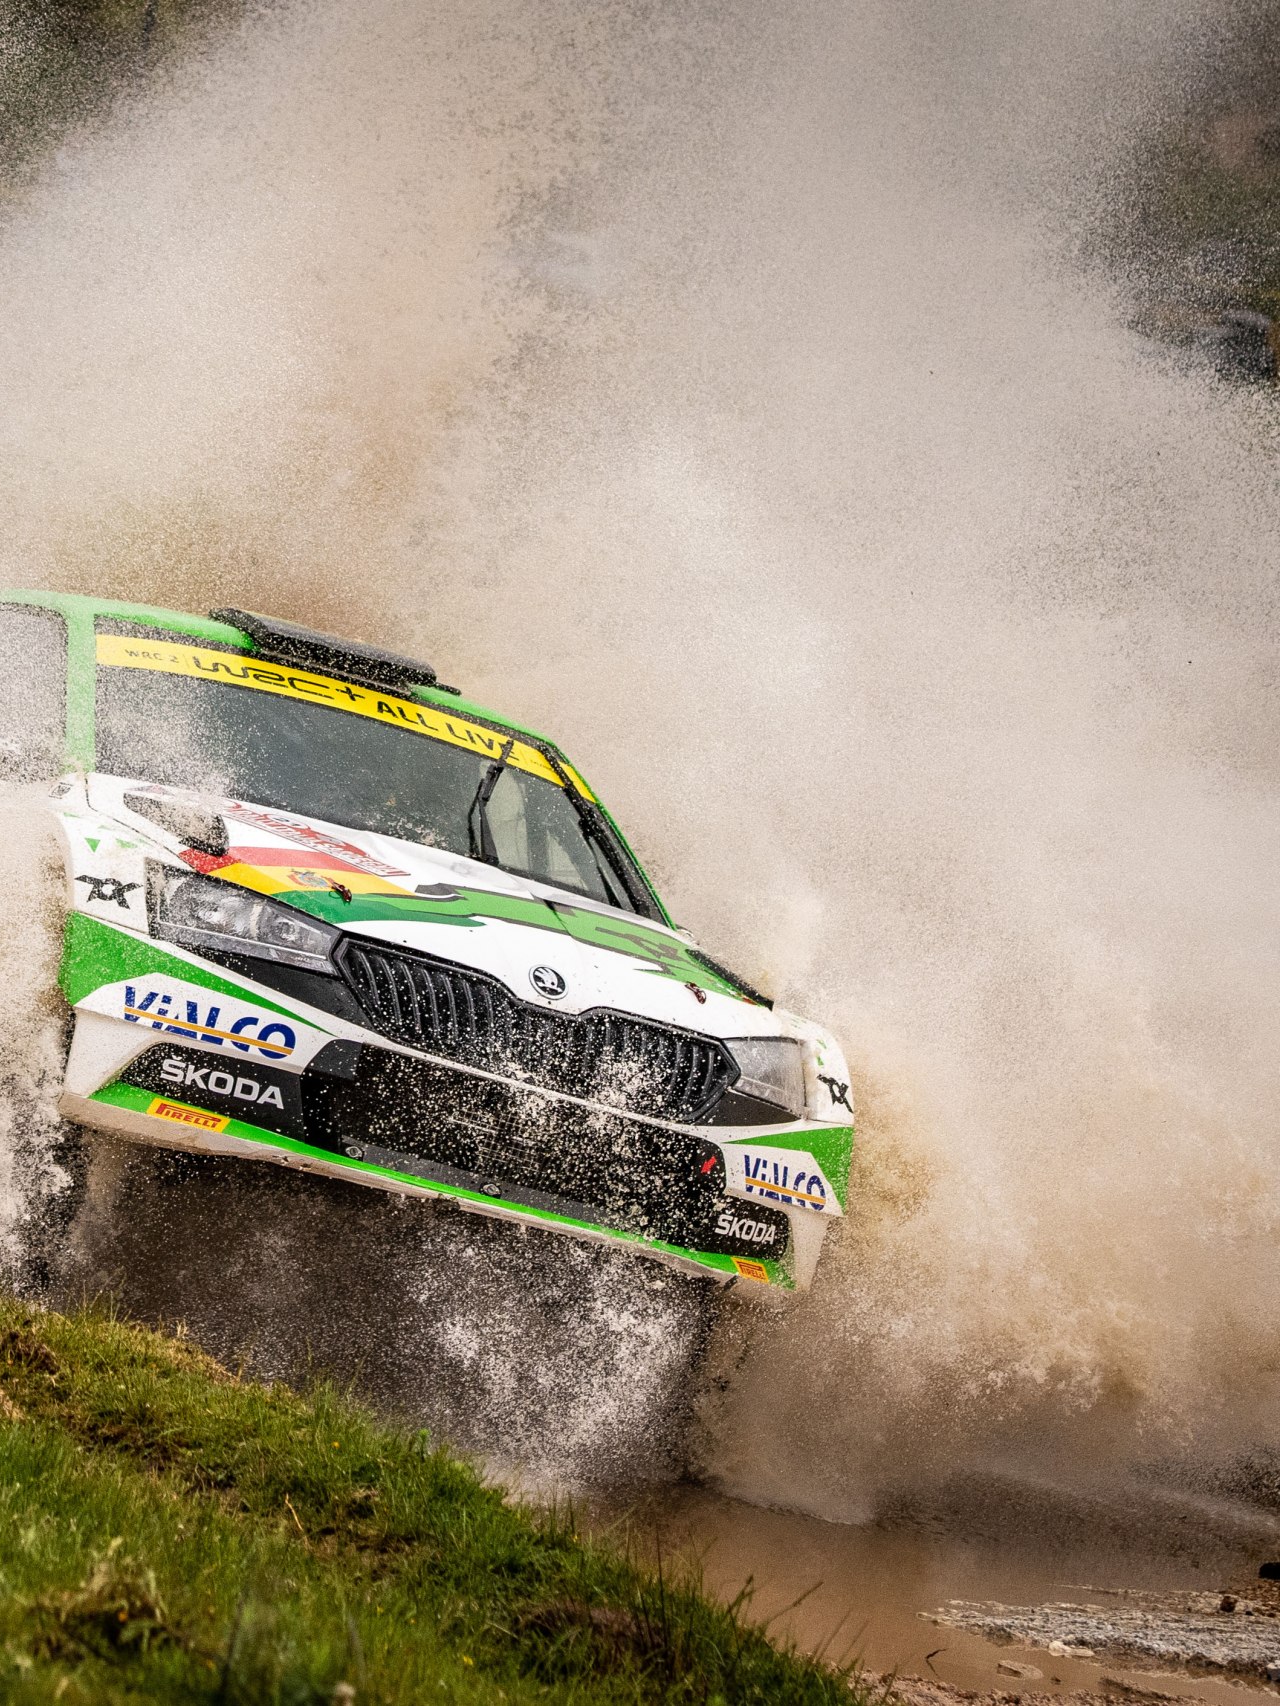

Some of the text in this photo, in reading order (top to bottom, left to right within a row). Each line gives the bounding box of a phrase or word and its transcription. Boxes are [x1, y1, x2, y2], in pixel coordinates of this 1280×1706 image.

[125, 649, 163, 661] WRC
[377, 701, 439, 731] ALL
[160, 1055, 284, 1110] ŠKODA
[155, 1103, 222, 1128] PIRELLI
